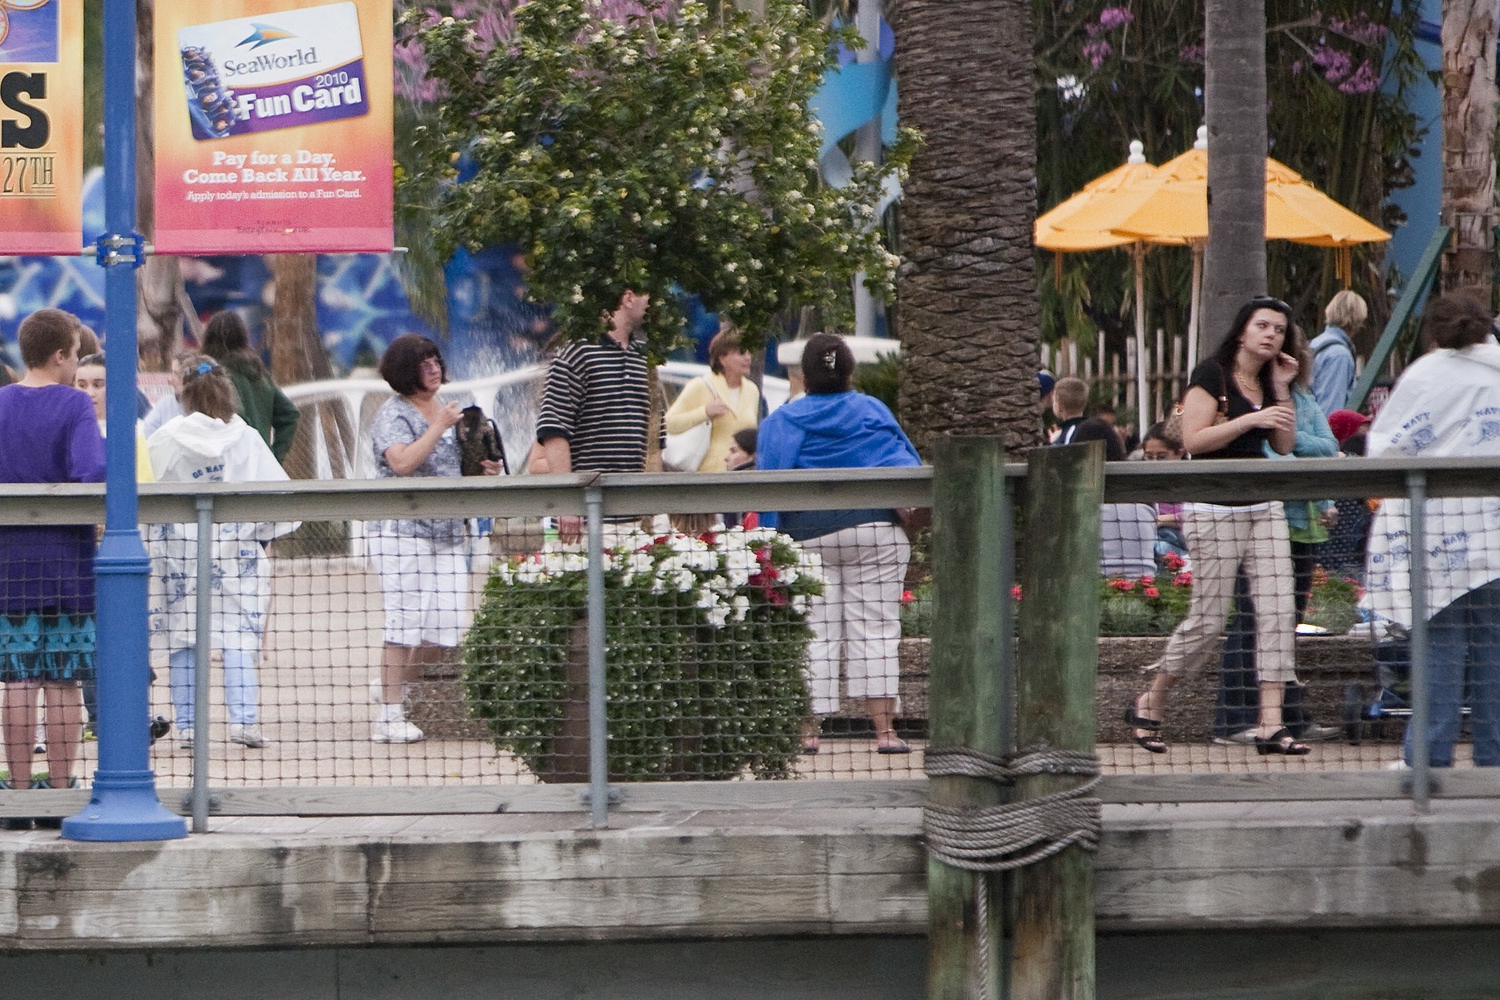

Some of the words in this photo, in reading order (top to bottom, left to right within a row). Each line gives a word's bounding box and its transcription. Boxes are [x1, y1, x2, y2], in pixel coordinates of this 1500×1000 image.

[223, 47, 318, 78] SeaWorld
[315, 71, 349, 88] 2010
[238, 93, 292, 121] Fun
[293, 77, 362, 113] Card
[212, 151, 248, 169] Pay
[250, 150, 277, 165] for
[281, 153, 293, 165] a
[297, 150, 337, 168] Day.
[2, 156, 55, 193] 27TH
[183, 169, 238, 184] Come
[241, 168, 288, 182] Back
[290, 167, 319, 182] All
[320, 167, 367, 182] Year.
[186, 191, 215, 202] Apply
[216, 190, 249, 202] today's
[250, 189, 297, 199] admission
[298, 190, 309, 199] to
[310, 191, 316, 199] a
[317, 189, 335, 199] Fun
[336, 188, 362, 198] Card.
